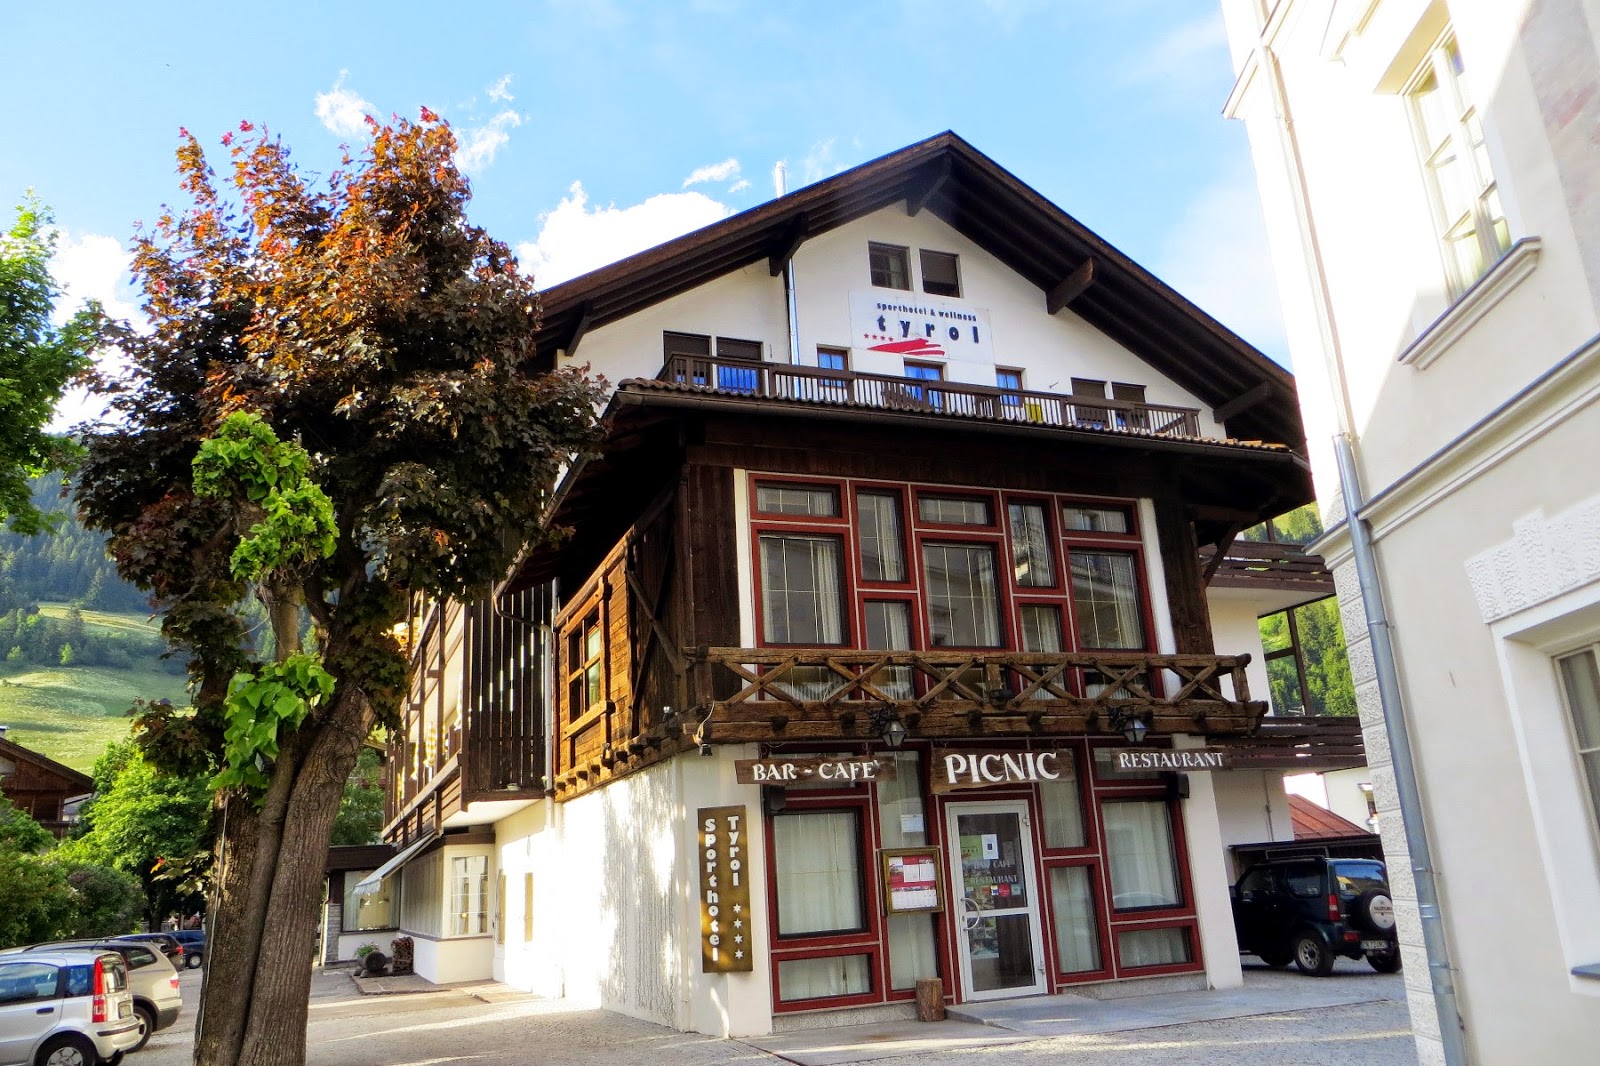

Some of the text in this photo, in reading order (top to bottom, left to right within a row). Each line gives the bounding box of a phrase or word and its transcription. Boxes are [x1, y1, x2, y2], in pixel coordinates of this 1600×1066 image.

[877, 302, 977, 322] sporthotel & wellness
[877, 314, 979, 344] tyrol
[752, 763, 797, 781] BAR
[943, 752, 1060, 784] PICNIC
[1119, 752, 1223, 768] RESTAURANT
[727, 816, 741, 886] Tyrol
[704, 818, 720, 962] Sporthotel
[970, 874, 1017, 885] RESTAURANT
